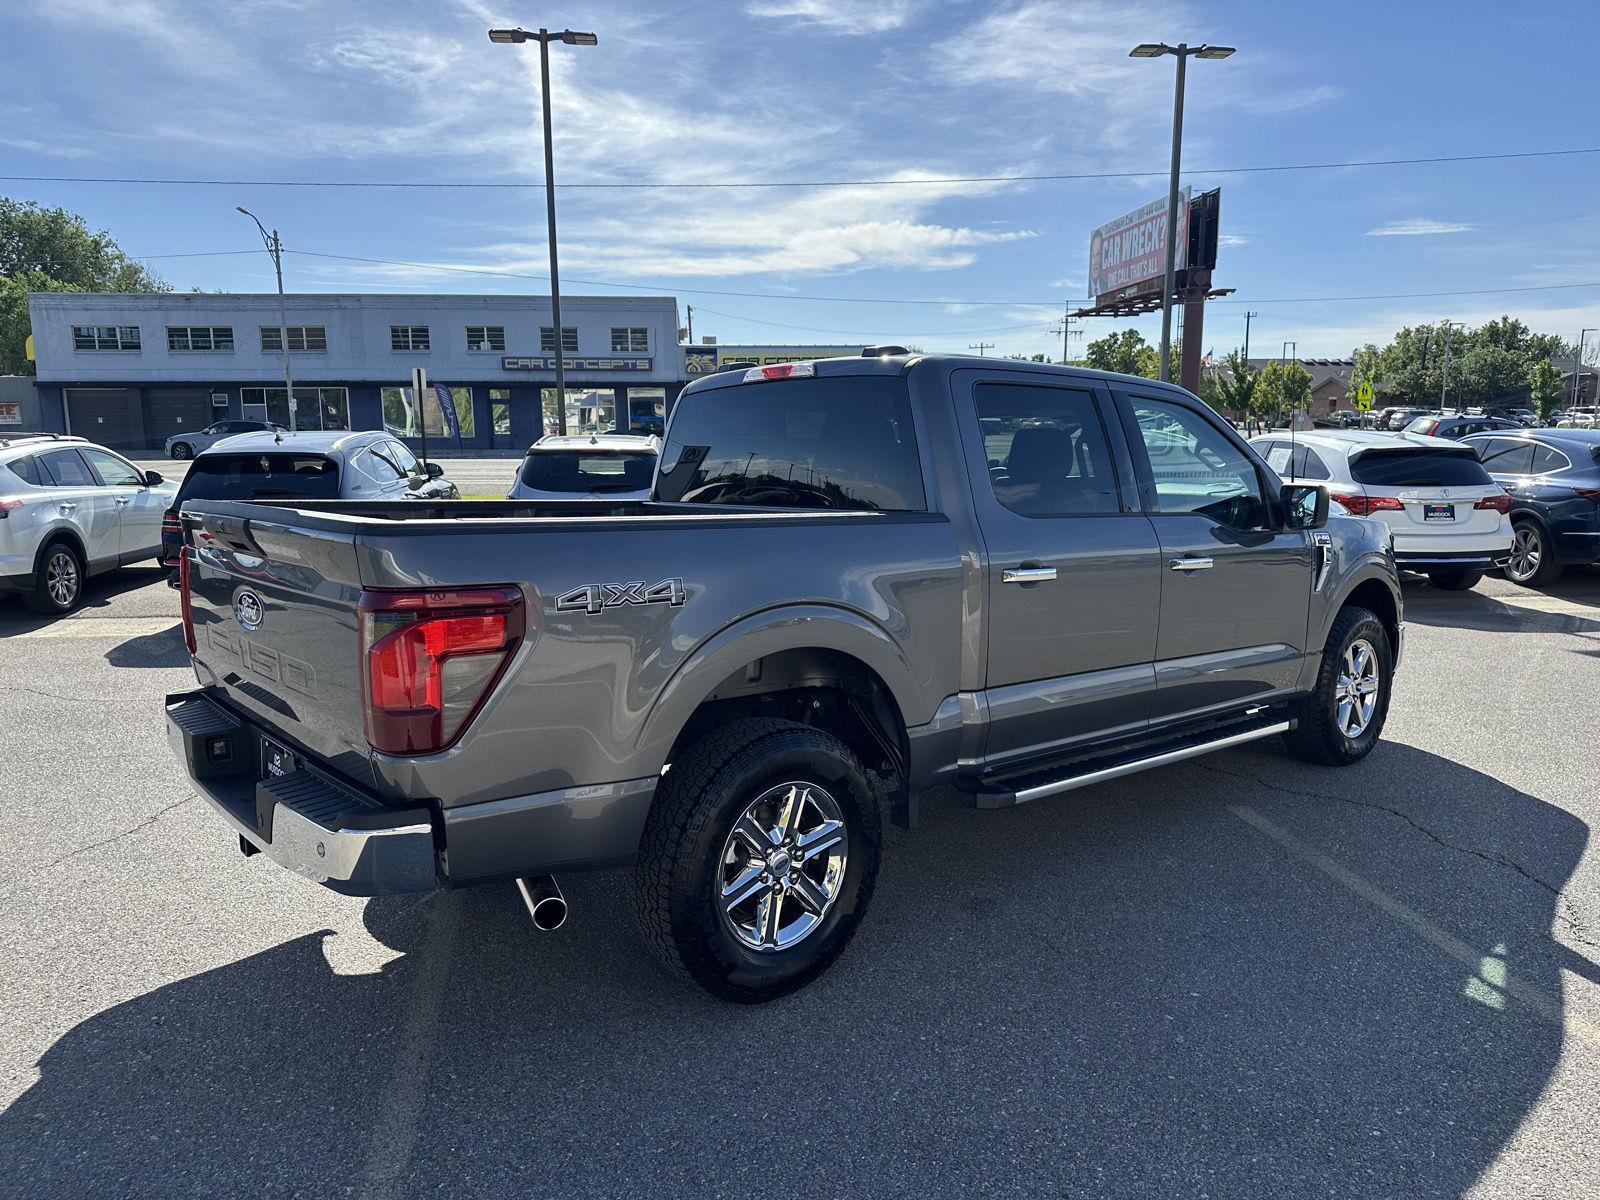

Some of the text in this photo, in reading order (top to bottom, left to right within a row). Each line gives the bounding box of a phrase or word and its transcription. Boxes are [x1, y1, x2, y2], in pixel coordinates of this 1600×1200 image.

[1102, 236, 1120, 270] CAR
[1121, 215, 1168, 262] WRECK?
[1118, 266, 1130, 284] CALL
[1148, 256, 1158, 275] ALL
[504, 358, 650, 369] CAR CONCEPTS
[240, 595, 260, 621] Ford
[206, 619, 318, 701] F-150
